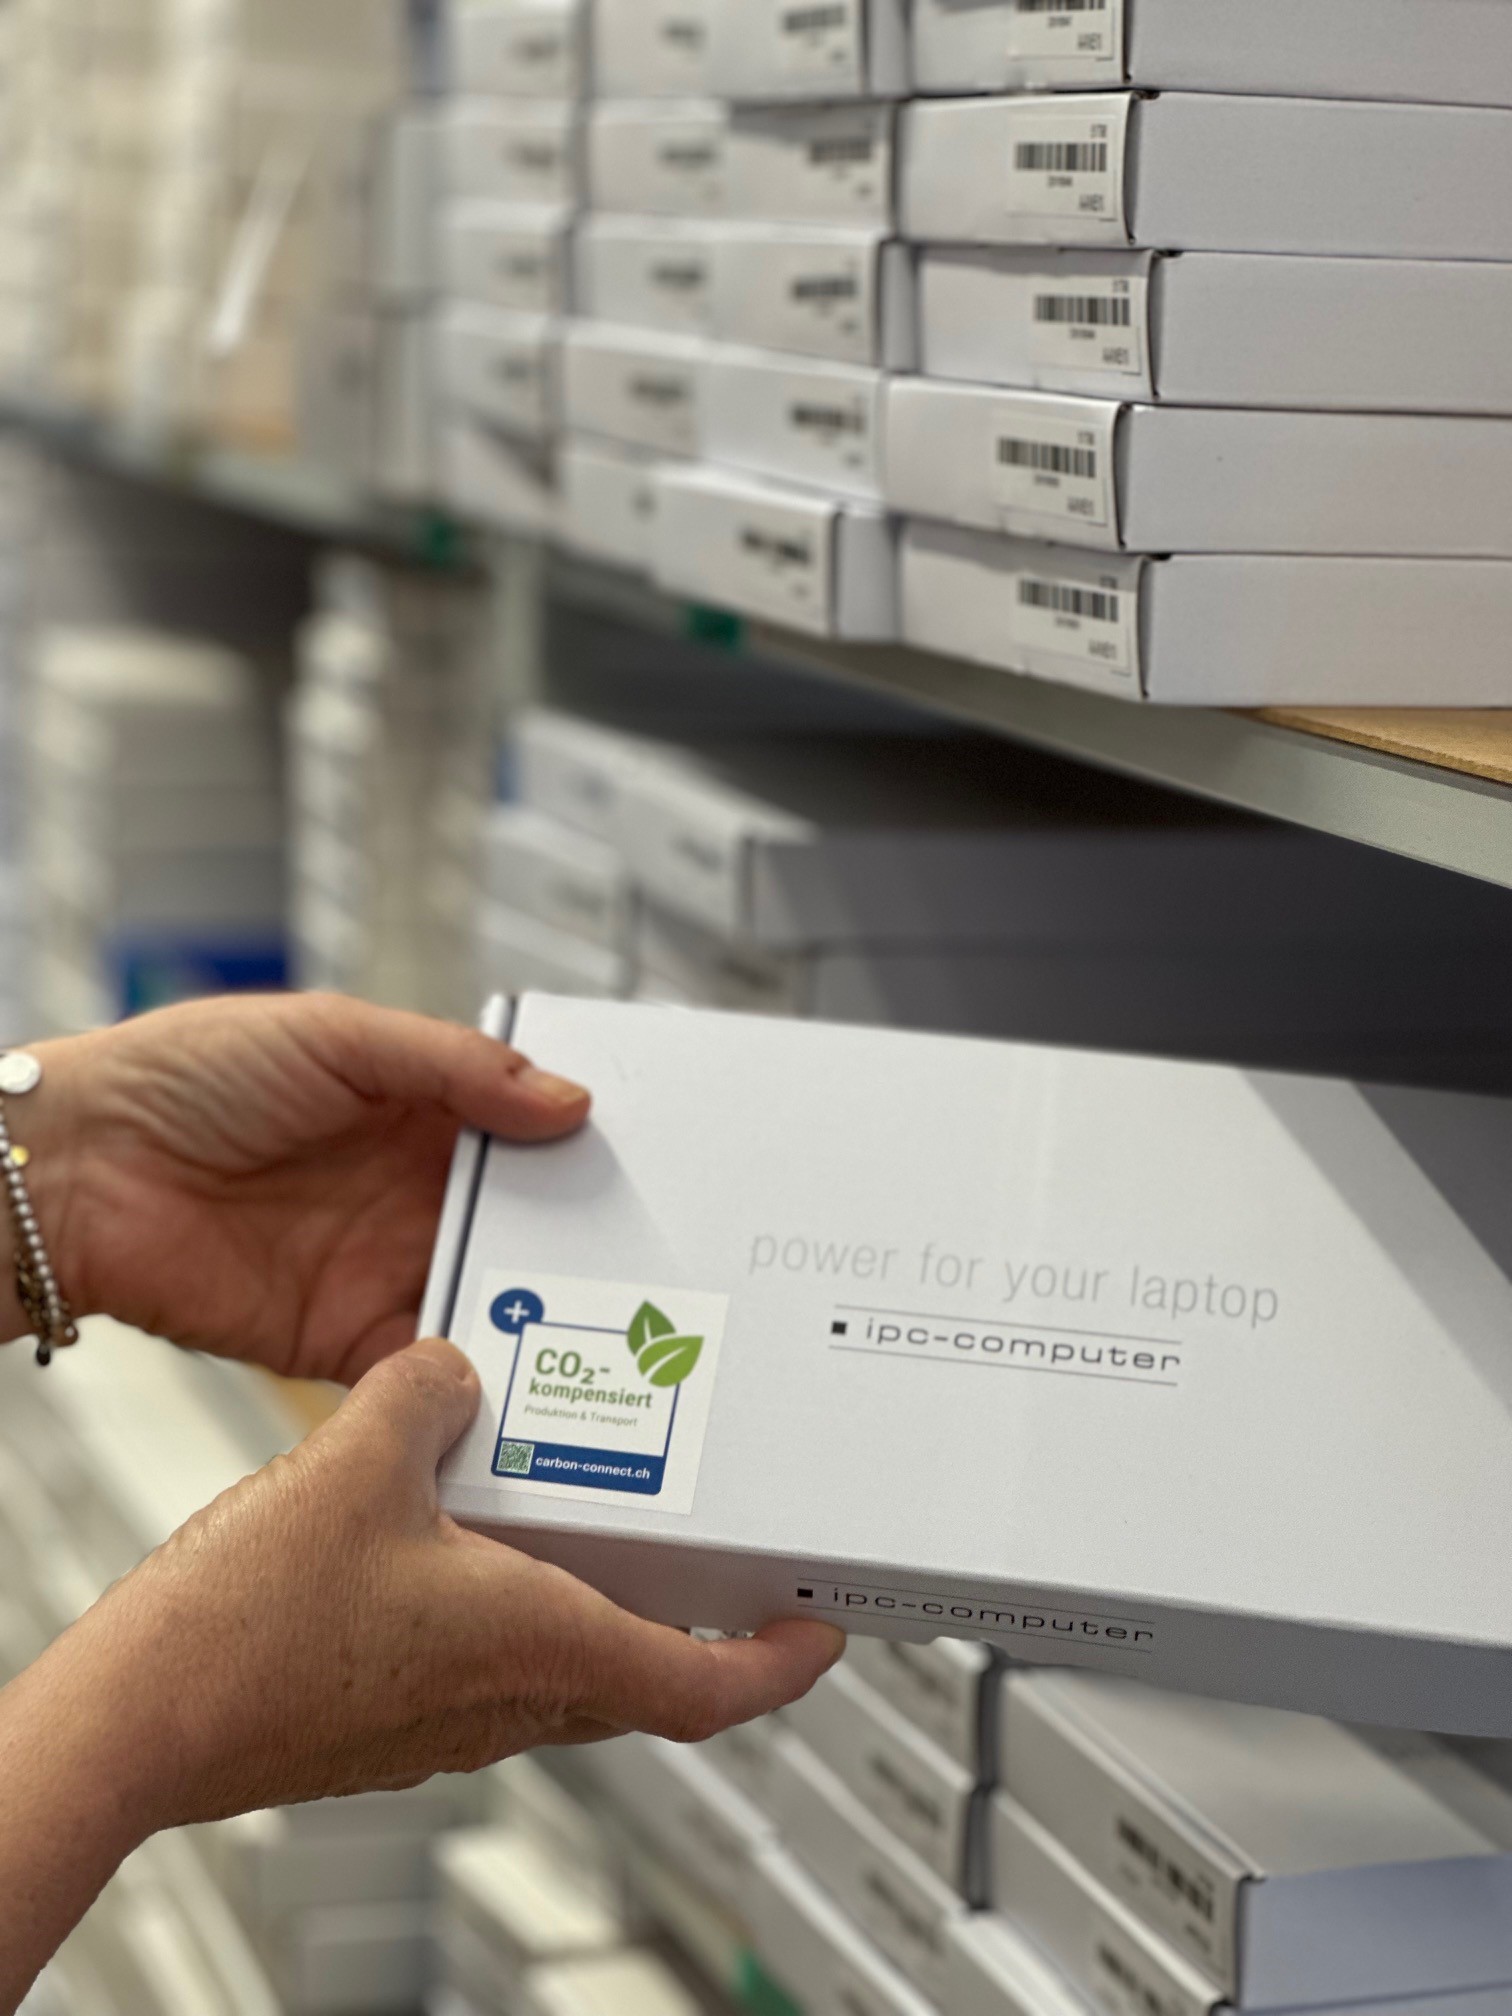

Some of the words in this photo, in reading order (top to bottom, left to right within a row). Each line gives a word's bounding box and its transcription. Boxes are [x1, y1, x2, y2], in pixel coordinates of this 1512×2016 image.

[748, 1233, 897, 1281] power
[919, 1242, 983, 1290] for
[1000, 1260, 1108, 1302] your
[1130, 1266, 1279, 1329] laptop
[865, 1318, 1181, 1372] ipc-computer
[529, 1377, 652, 1408] kompensiert
[524, 1404, 577, 1419] Produktion
[580, 1411, 587, 1420] &
[590, 1411, 638, 1426] Transport
[536, 1456, 651, 1480] carbon-connect.ch
[833, 1587, 1153, 1642] ipc-computer
